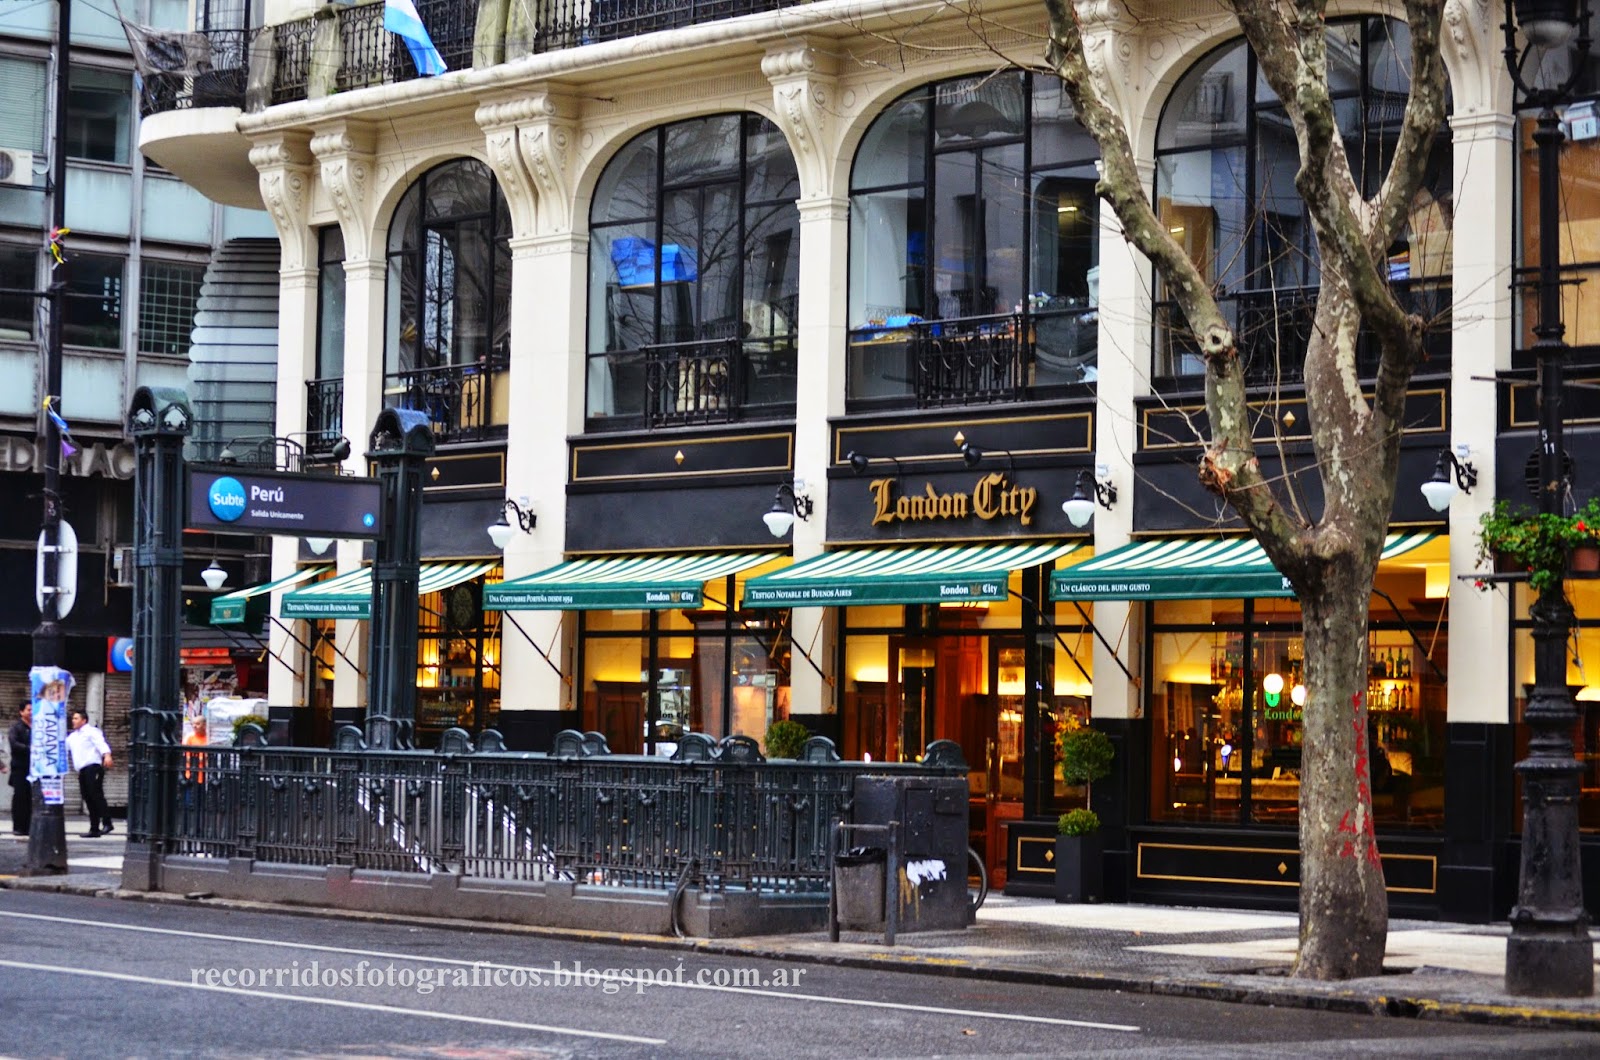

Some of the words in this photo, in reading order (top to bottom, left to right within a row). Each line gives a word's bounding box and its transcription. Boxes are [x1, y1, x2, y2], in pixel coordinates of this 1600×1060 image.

[1543, 442, 1555, 455] 11
[213, 492, 245, 507] Subte
[251, 485, 284, 502] Perú
[869, 478, 968, 526] London
[973, 472, 1037, 526] City
[251, 509, 269, 518] Salida
[269, 511, 304, 521] Unicamente
[776, 589, 802, 599] NOTABLE
[811, 589, 834, 598] BUENOS
[835, 588, 852, 597] AIRES
[940, 584, 969, 597] London
[982, 583, 998, 596] City
[1097, 584, 1110, 592] DEL
[1111, 584, 1128, 592] BUEN
[1129, 583, 1151, 592] GUSTO
[646, 592, 670, 604] London
[681, 591, 694, 603] City
[45, 711, 58, 767] TAIANA
